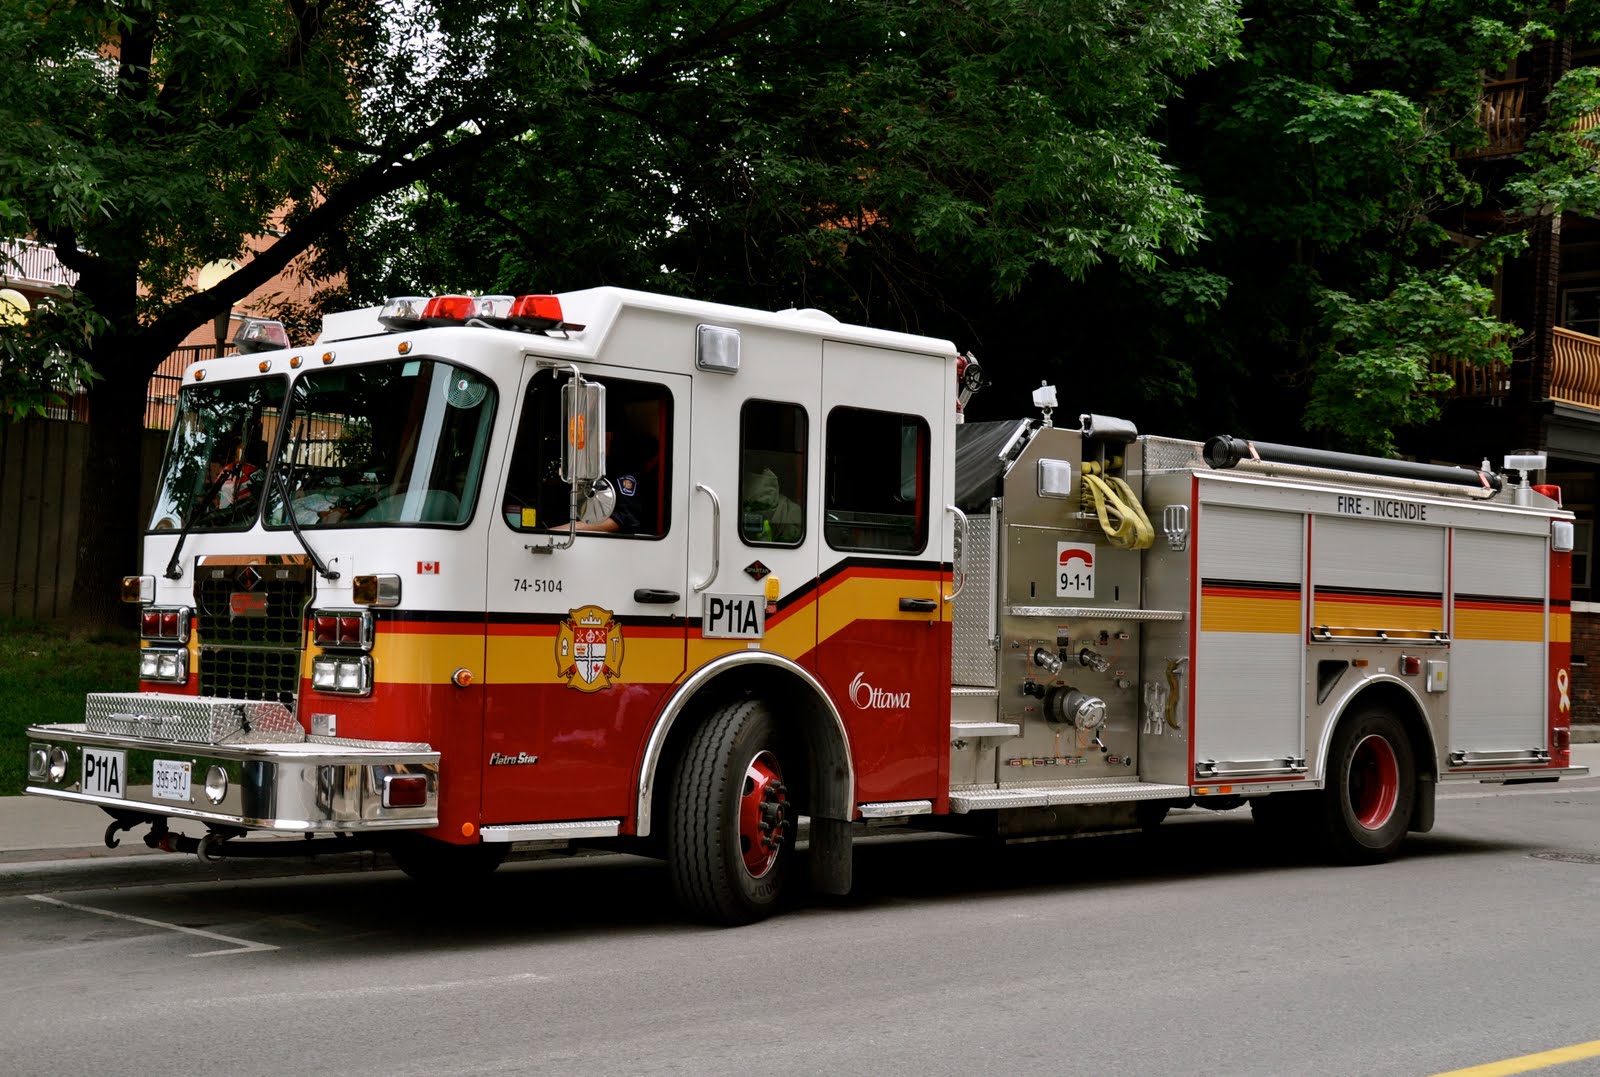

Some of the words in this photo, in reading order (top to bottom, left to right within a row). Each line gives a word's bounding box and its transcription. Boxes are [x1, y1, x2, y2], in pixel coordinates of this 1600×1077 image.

[1338, 496, 1362, 514] FIRE
[1374, 500, 1426, 520] INCENDIE
[514, 579, 562, 592] 74-5104
[1061, 573, 1091, 591] 9-1-1
[709, 598, 759, 634] P11A
[849, 672, 911, 710] Ottawa
[489, 753, 517, 765] Metro
[517, 752, 538, 764] Star
[85, 754, 119, 793] P11A
